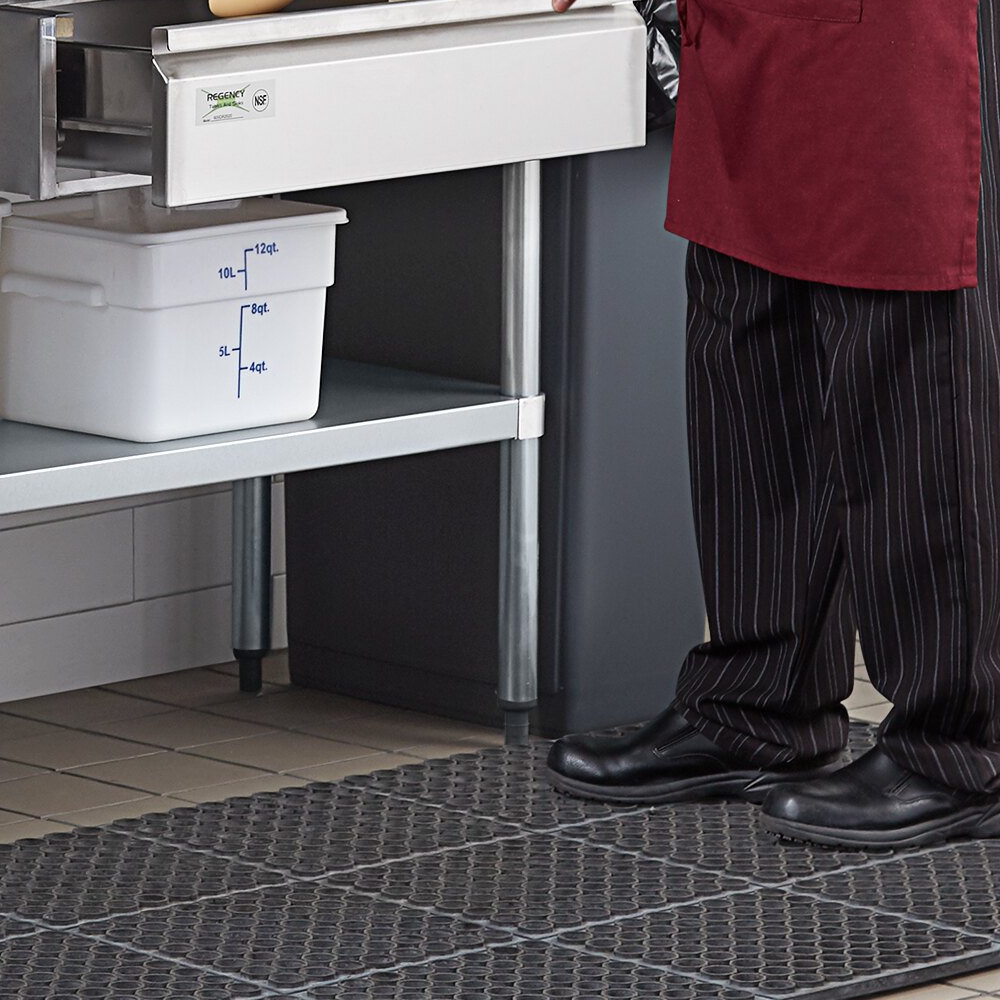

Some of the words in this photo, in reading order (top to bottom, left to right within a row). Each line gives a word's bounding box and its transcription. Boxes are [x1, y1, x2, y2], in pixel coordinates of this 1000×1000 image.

[206, 89, 246, 101] REGENCY
[254, 94, 267, 106] NSF
[254, 242, 279, 256] 12qt.
[218, 267, 236, 279] 10L
[251, 302, 270, 316] 8qt.
[219, 346, 230, 357] 5L
[249, 361, 268, 374] 4qt.
